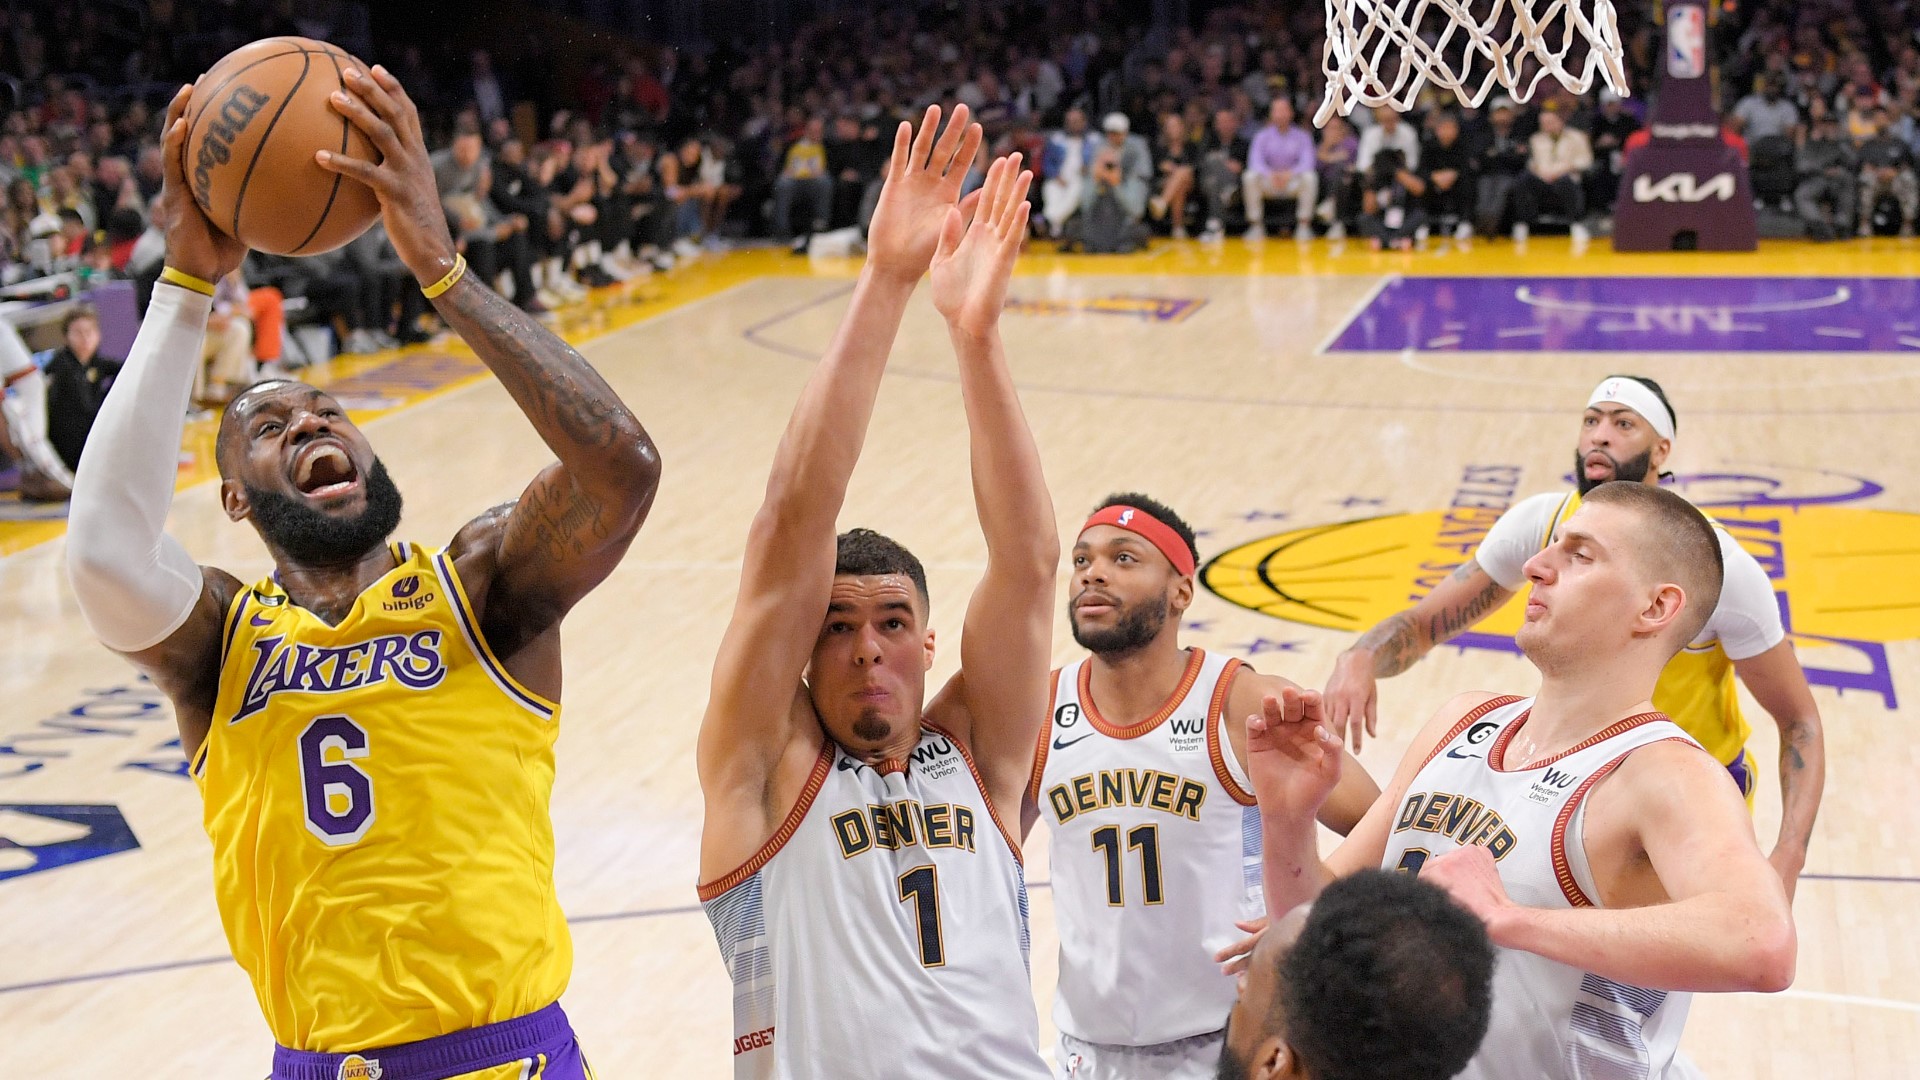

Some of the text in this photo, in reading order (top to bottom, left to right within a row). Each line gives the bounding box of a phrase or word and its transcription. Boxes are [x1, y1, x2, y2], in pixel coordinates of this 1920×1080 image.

[195, 84, 270, 212] Wilson
[1633, 172, 1735, 202] KIA
[382, 592, 435, 611] bibigo
[227, 629, 449, 727] LAKERS
[1170, 718, 1204, 735] WU
[911, 737, 951, 764] WU
[1169, 736, 1204, 745] Western
[1174, 744, 1199, 752] Union
[919, 756, 959, 775] Western
[930, 766, 958, 780] Union
[297, 713, 376, 846] 6
[1530, 782, 1560, 798] Western
[1541, 767, 1577, 789] WU
[1047, 768, 1207, 825] DENVER
[1528, 791, 1549, 804] Union
[1394, 792, 1518, 862] DENVER
[1090, 823, 1164, 907] 11
[898, 864, 945, 968] 1
